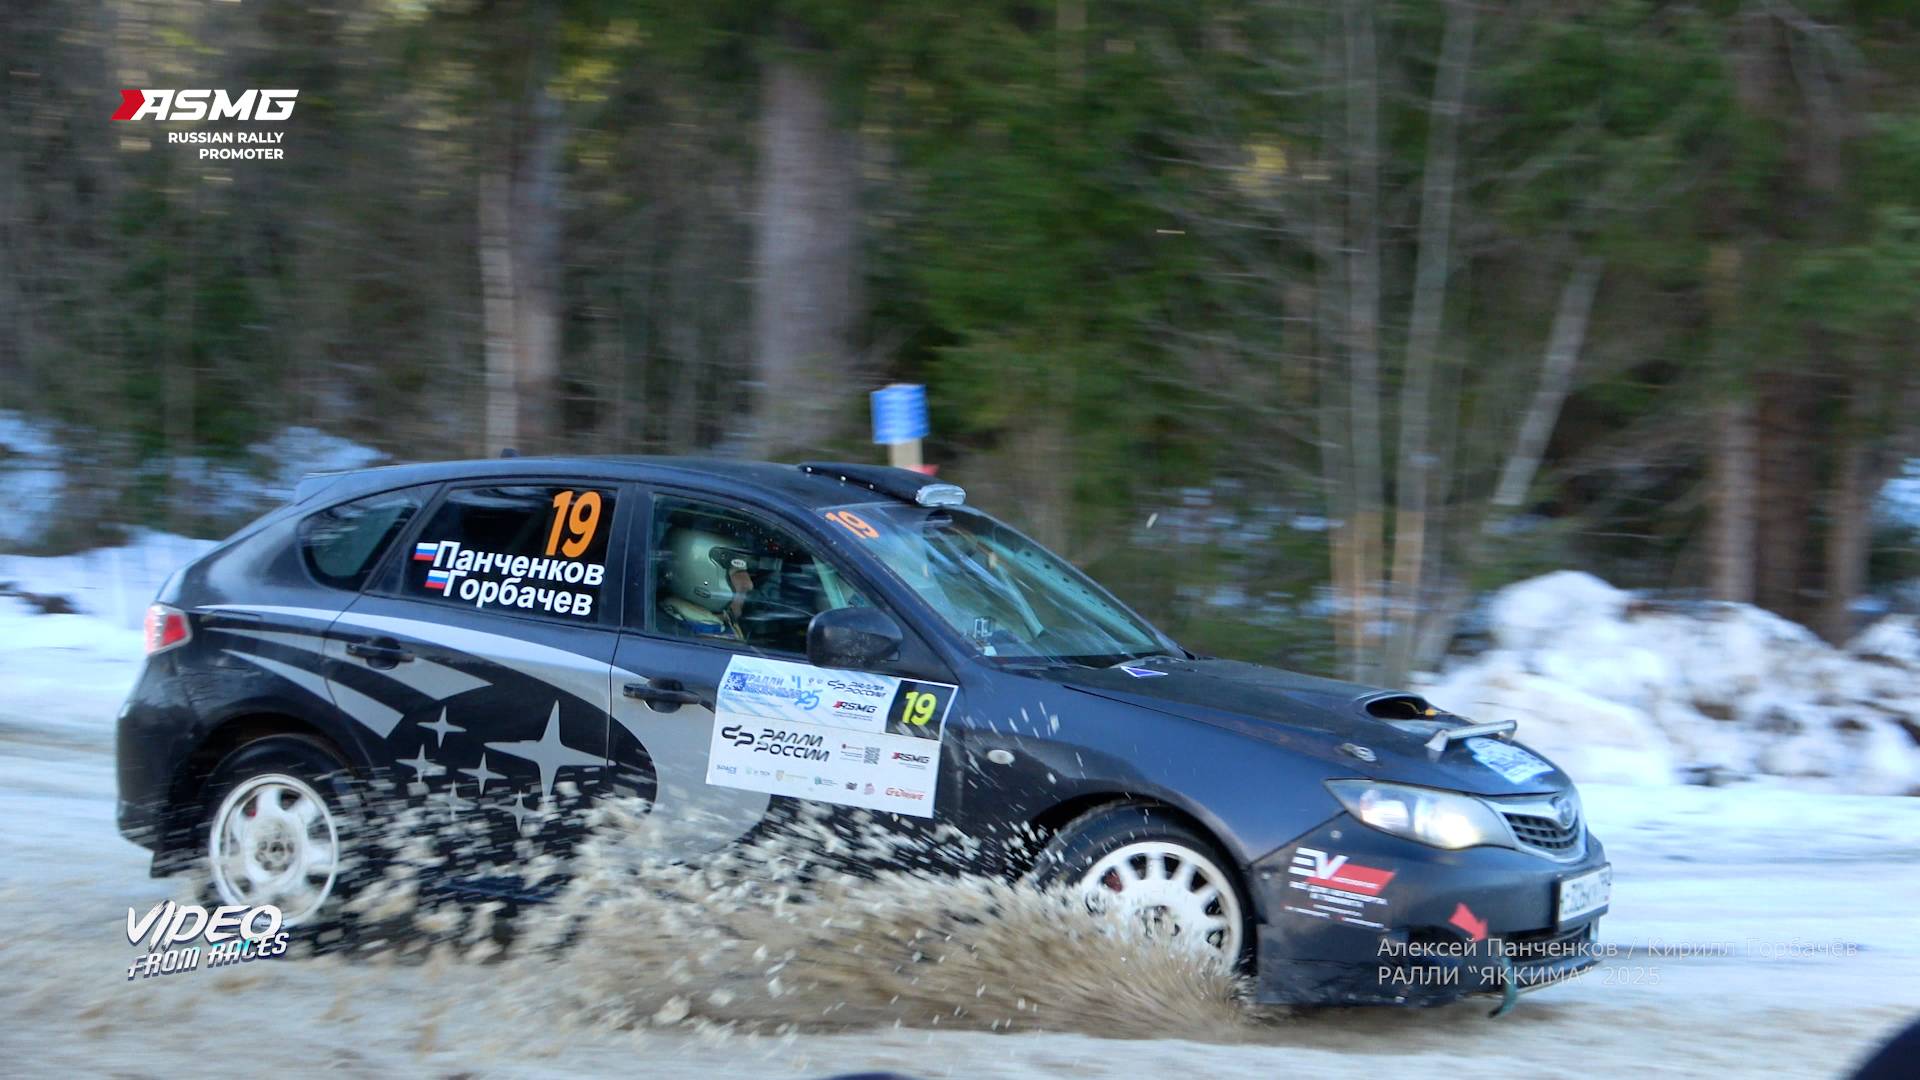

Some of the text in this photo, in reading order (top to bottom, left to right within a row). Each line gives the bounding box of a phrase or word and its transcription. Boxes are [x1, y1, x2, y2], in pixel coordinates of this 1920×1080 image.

[545, 489, 602, 558] 19
[825, 511, 879, 539] 19
[433, 540, 605, 586] Панченков
[443, 570, 593, 616] Горбачев
[902, 691, 937, 726] 19
[753, 741, 830, 762] РОССИИ
[759, 728, 824, 747] РАЛЛИ
